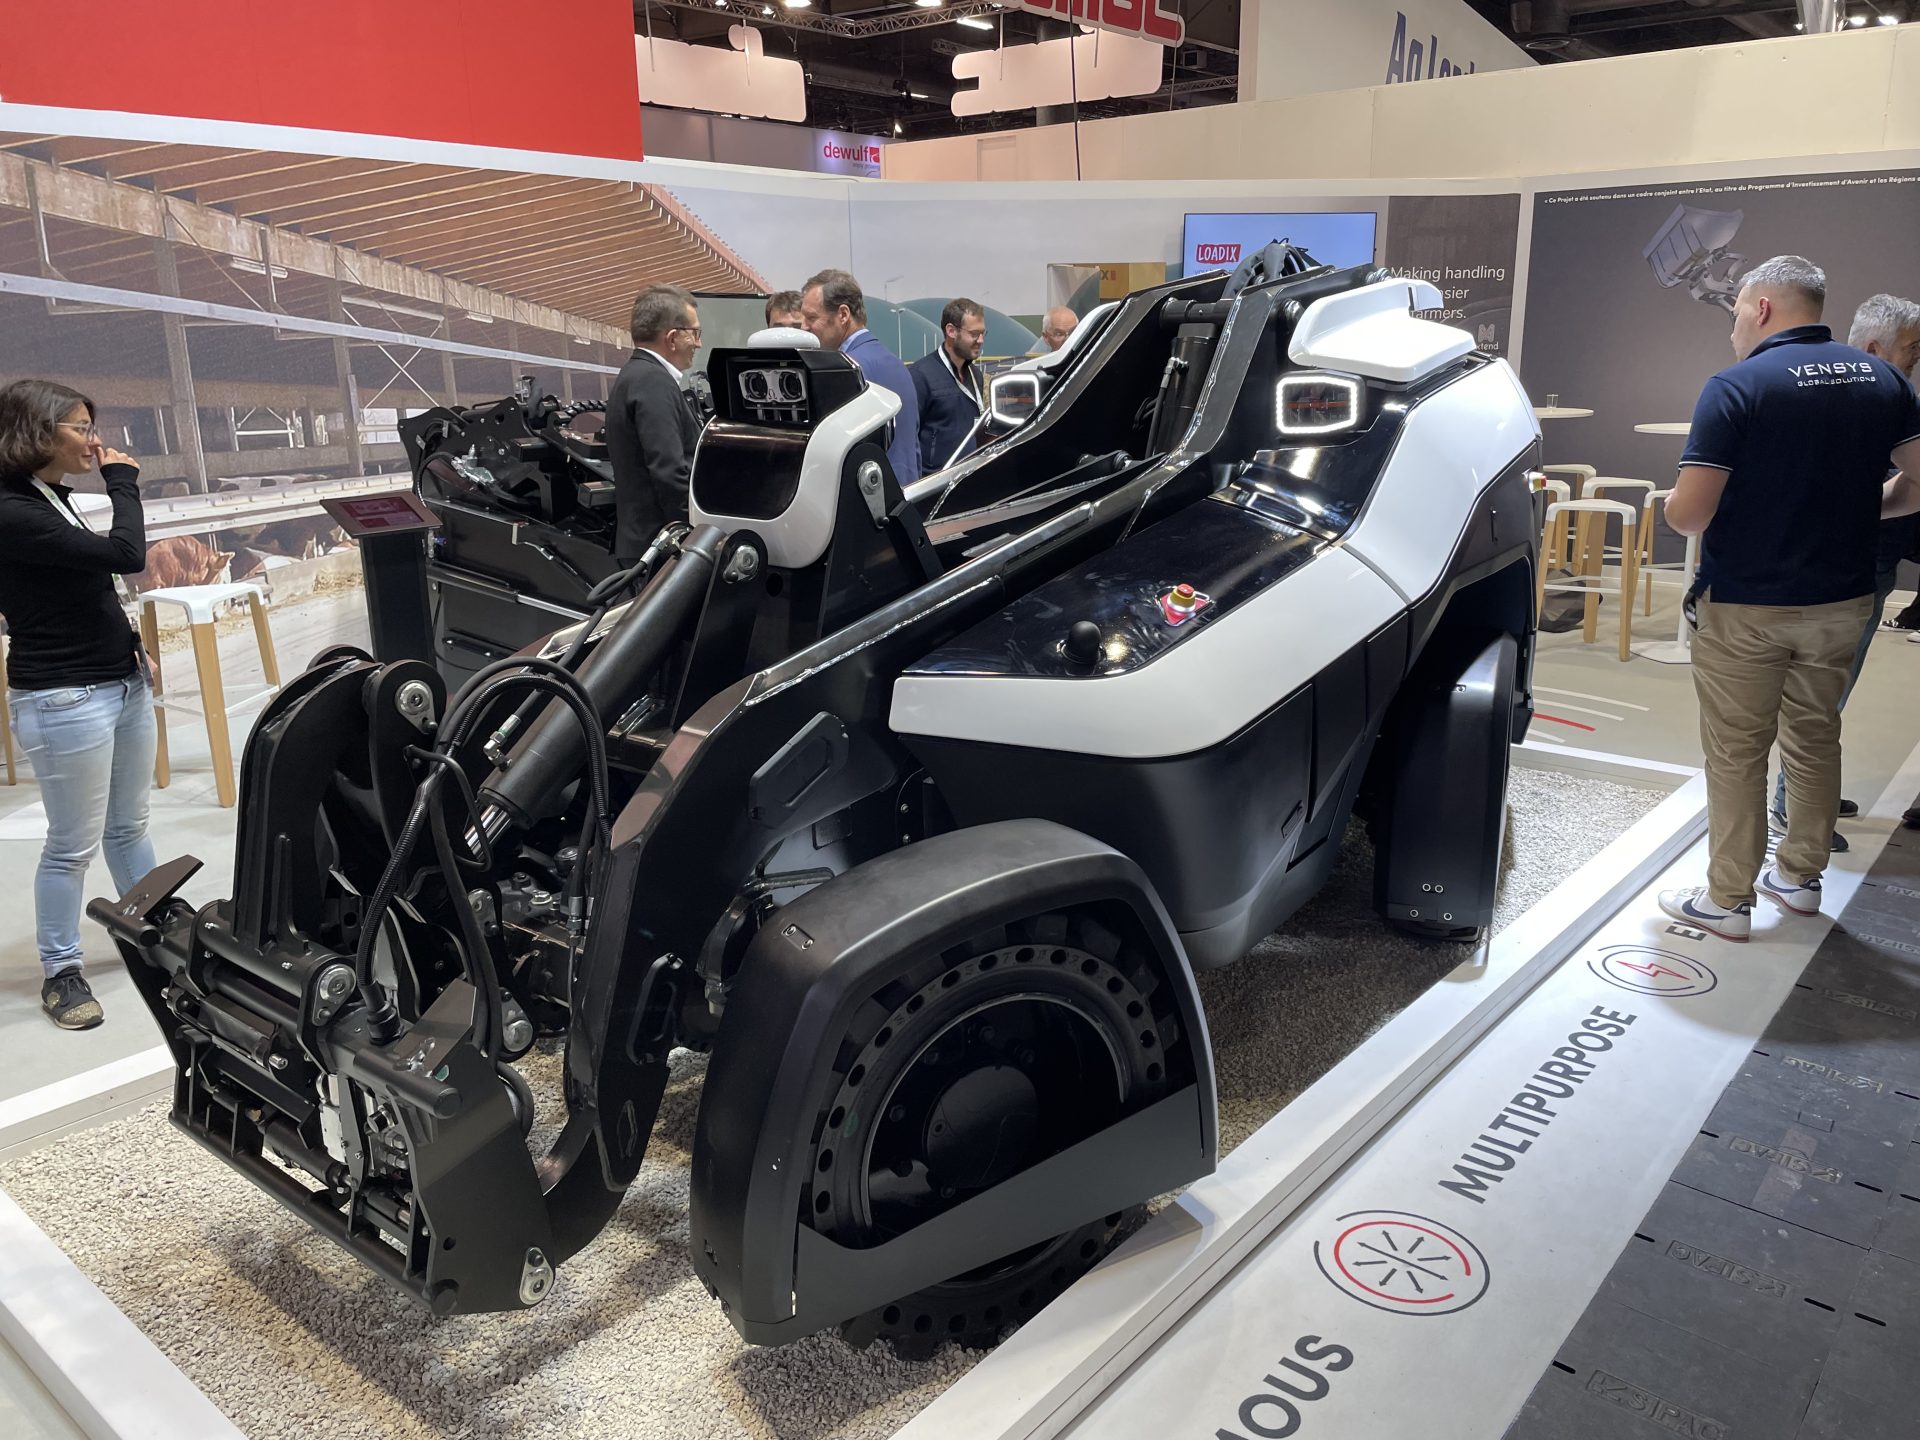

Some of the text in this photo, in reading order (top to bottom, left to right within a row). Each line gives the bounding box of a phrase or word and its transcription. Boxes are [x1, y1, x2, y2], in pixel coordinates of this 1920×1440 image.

[823, 141, 869, 162] dewulf
[1557, 196, 1574, 204] Projet
[1636, 190, 1653, 198] cadre
[1654, 189, 1678, 198] conjoint
[1724, 184, 1737, 192] titre
[1748, 182, 1785, 192] Programme
[1786, 180, 1840, 188] d'Investissement
[1841, 178, 1868, 186] d'Avenir
[1889, 175, 1916, 184] Régions
[1198, 246, 1238, 263] LOADIX
[1391, 265, 1505, 282] Making handling
[1787, 362, 1873, 378] VENSYS
[1797, 376, 1876, 387] GLOBAL SOLUTIONS
[1438, 1005, 1638, 1204] MULTIPURPOSE
[1216, 1334, 1354, 1440] OUS
